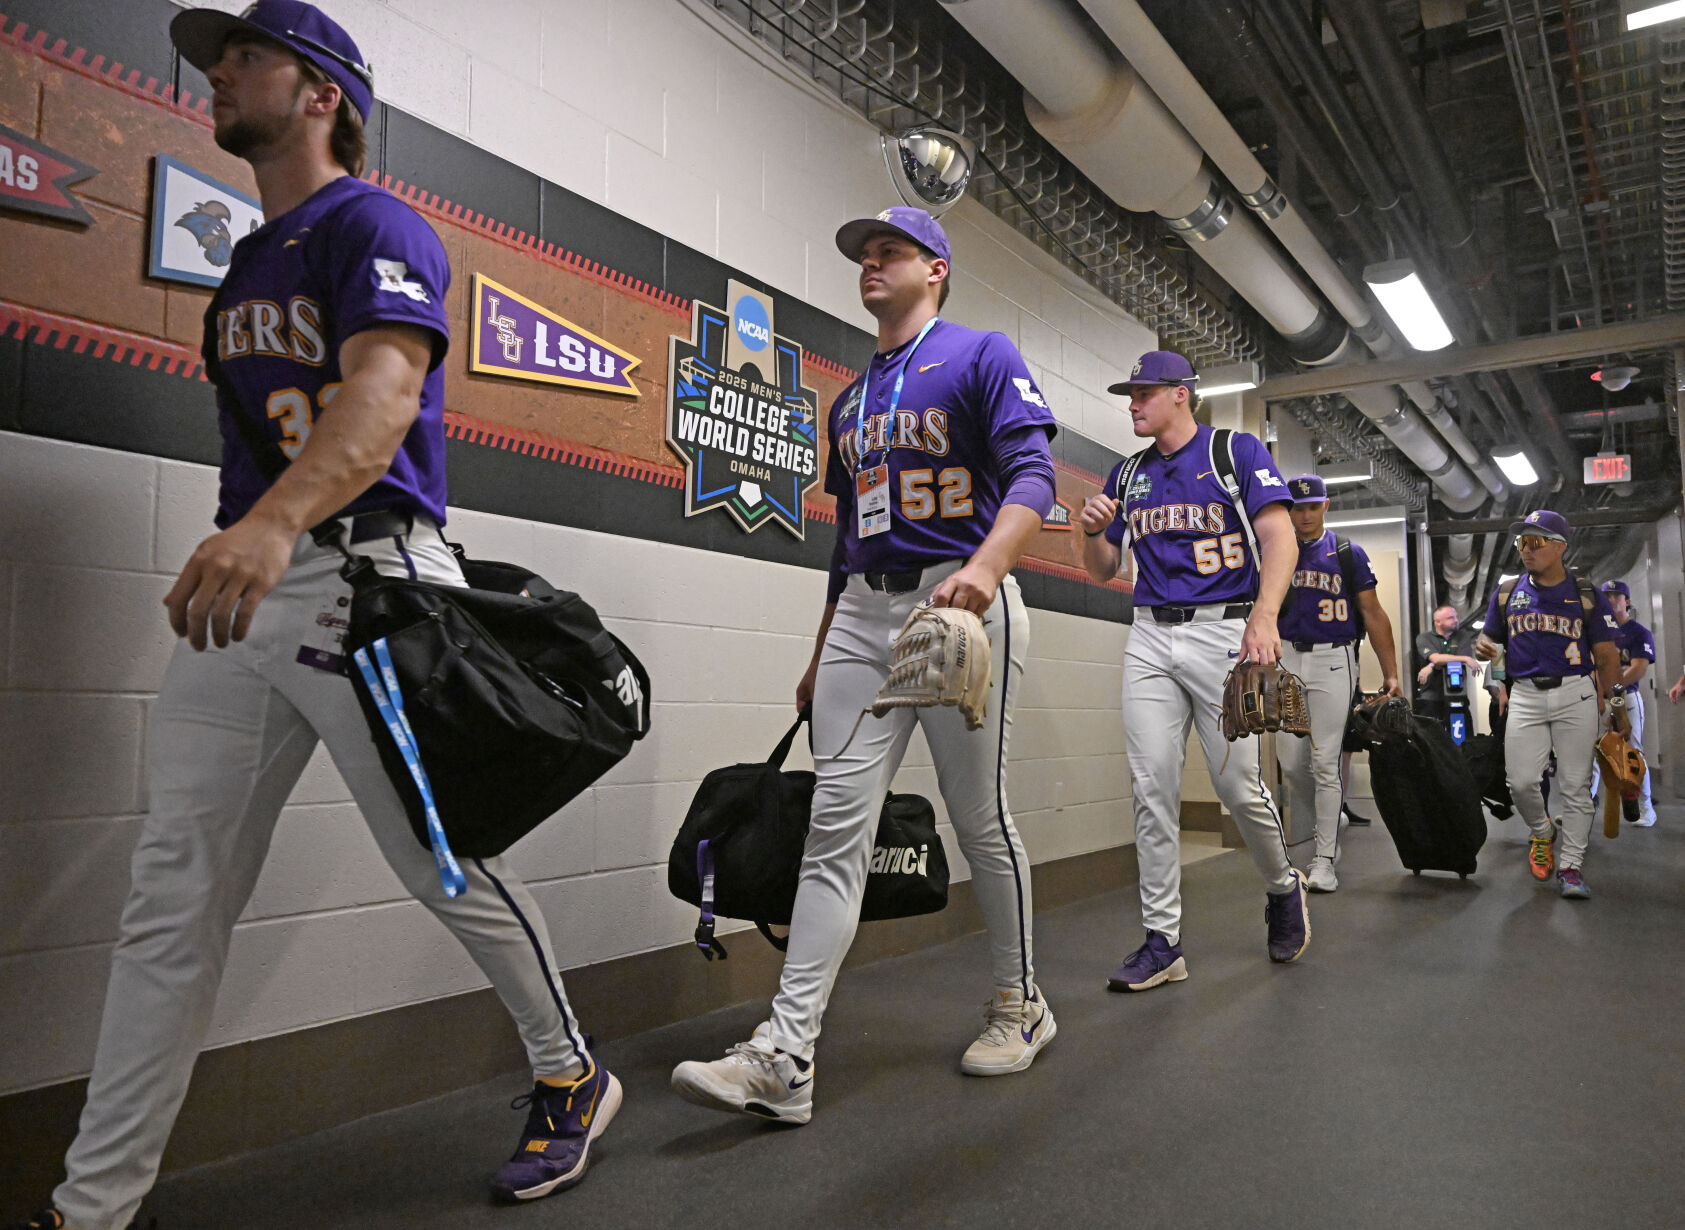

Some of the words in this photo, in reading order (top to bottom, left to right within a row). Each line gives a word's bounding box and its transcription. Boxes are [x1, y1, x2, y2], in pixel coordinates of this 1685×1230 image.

[217, 296, 326, 366] ERS
[738, 318, 768, 344] NCAA
[534, 320, 616, 378] LSU
[719, 371, 747, 389] 2025
[751, 382, 781, 402] MEN'S
[266, 387, 343, 464] 3
[709, 385, 790, 436] COLLEGE
[678, 408, 749, 456] WORLD
[752, 433, 814, 475] SERIES
[730, 460, 771, 481] OMAHA
[1121, 457, 1136, 486] marucci
[1593, 457, 1624, 480] EXIT
[900, 467, 973, 519] 52
[1128, 503, 1225, 542] TIGERS
[1193, 532, 1244, 575] 55
[1291, 570, 1342, 595] GERS
[1318, 599, 1348, 621] 30
[1507, 612, 1582, 639] TIGERS
[956, 626, 966, 668] marucci
[1565, 641, 1581, 665] 4
[1452, 720, 1464, 739] t
[870, 844, 928, 877] aruci
[525, 1139, 550, 1152] NIKE
